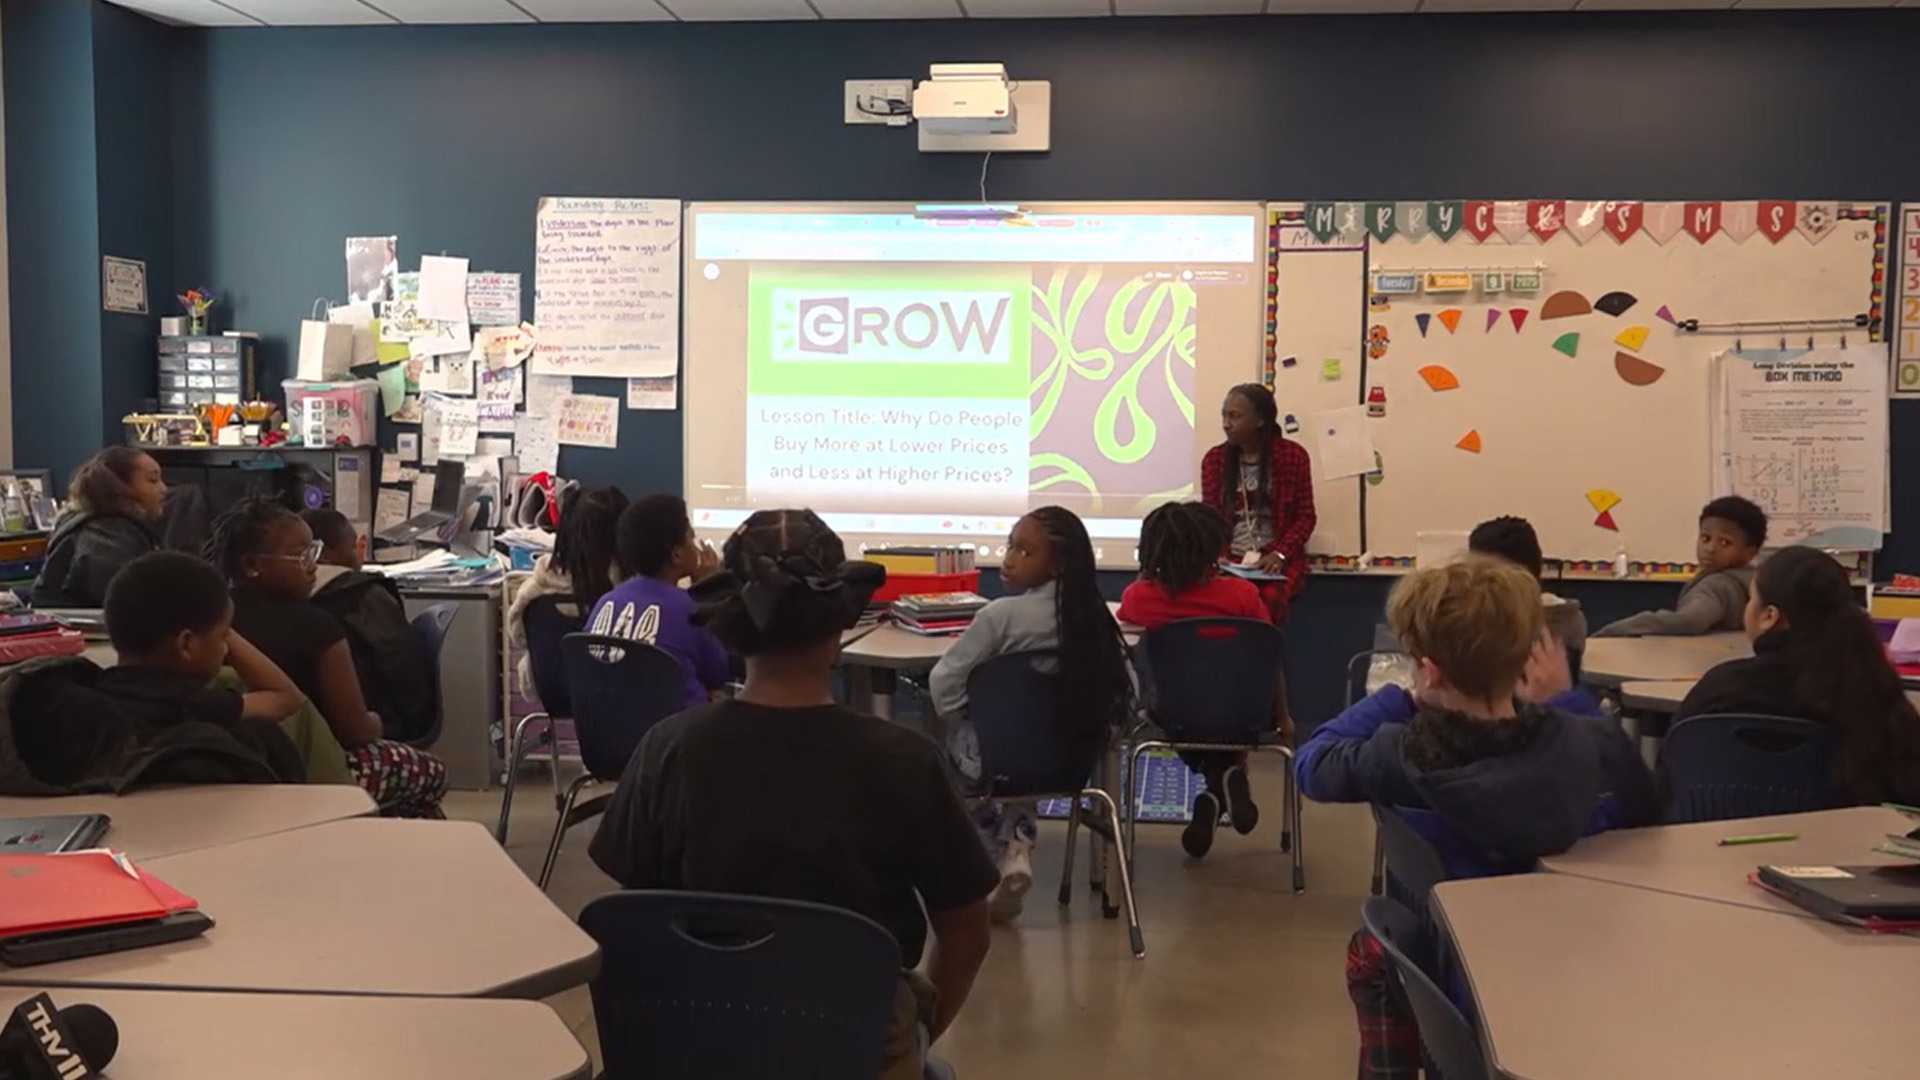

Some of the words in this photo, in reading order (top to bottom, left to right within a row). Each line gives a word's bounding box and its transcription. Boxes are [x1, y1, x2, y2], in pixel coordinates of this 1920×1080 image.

[1381, 275, 1412, 288] Tuesday
[1489, 276, 1498, 288] 9
[1907, 268, 1920, 290] 3
[1904, 299, 1920, 323] 2
[800, 298, 1011, 355] GROW
[1753, 362, 1774, 370] Long
[1814, 362, 1838, 370] using
[1901, 364, 1919, 386] 0
[1765, 371, 1788, 382] BOX
[1793, 371, 1842, 382] METHOD
[761, 409, 825, 424] Lesson
[831, 409, 876, 424] Title:
[881, 410, 922, 429] Why
[929, 411, 952, 425] Do
[959, 411, 1023, 429] People
[774, 436, 808, 454] Buy
[814, 437, 860, 452] More
[866, 439, 883, 453] at
[890, 438, 944, 453] Lower
[951, 438, 1009, 455] Prices
[770, 465, 803, 479] and
[809, 466, 850, 480] Less
[856, 467, 873, 481] at
[879, 467, 939, 485] Higher
[945, 467, 1014, 483] Prices?
